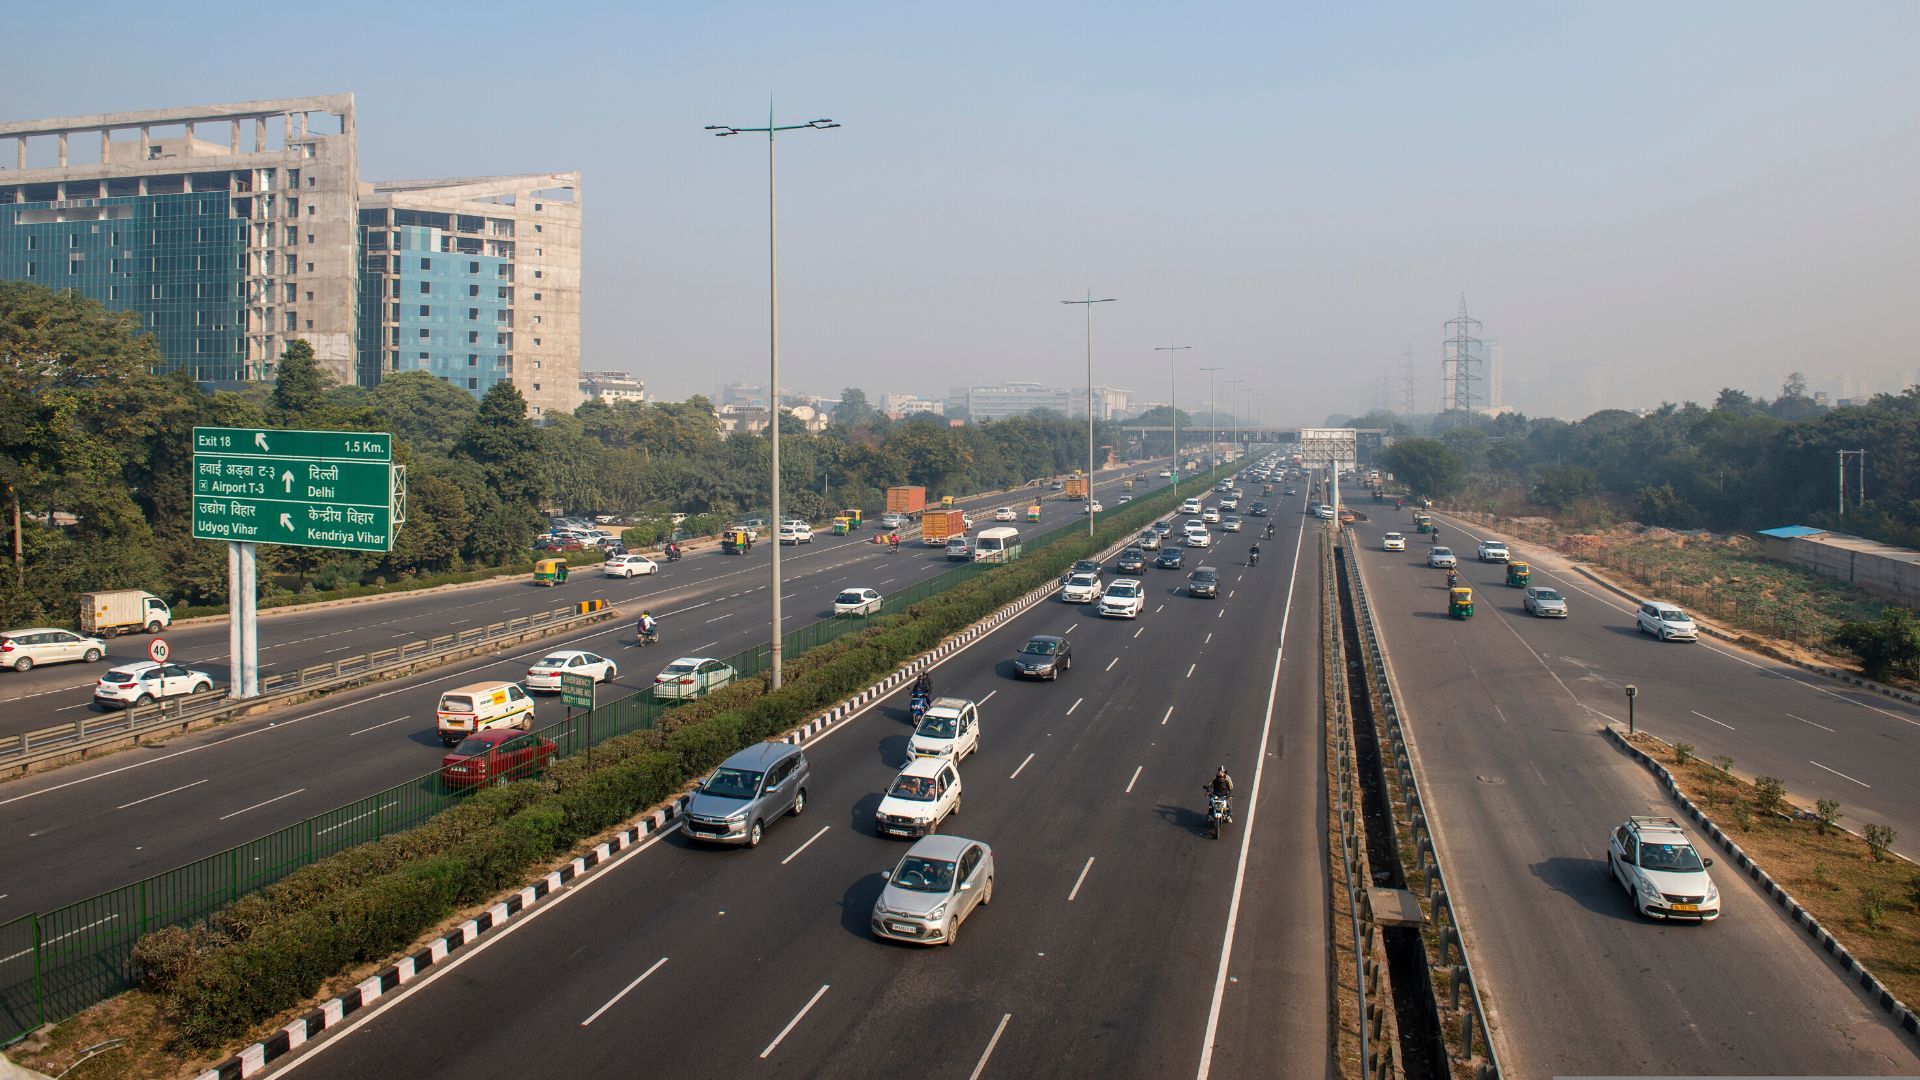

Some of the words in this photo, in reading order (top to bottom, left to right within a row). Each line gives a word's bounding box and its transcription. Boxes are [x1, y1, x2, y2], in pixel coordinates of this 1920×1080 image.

[199, 435, 218, 447] Exit
[219, 436, 232, 447] 18
[344, 440, 361, 452] 1.5
[362, 441, 385, 453] Km.
[199, 459, 222, 477] हवाई
[225, 464, 254, 479] अड्डा
[308, 464, 339, 481] दिल्ली
[211, 480, 247, 495] Airport
[248, 482, 265, 494] T-3
[307, 485, 335, 498] Delhi
[198, 499, 226, 515] उद्योग
[230, 500, 257, 518] विहार
[307, 505, 342, 523] केन्द्रीय
[346, 507, 375, 525] विहार
[198, 520, 229, 536] Udyog
[231, 522, 258, 535] Vihar
[307, 527, 354, 544] Kendriya
[356, 531, 386, 544] Vihar
[153, 645, 166, 656] 40
[563, 675, 592, 687] EMERGENCY
[562, 685, 584, 696] HELPLINE
